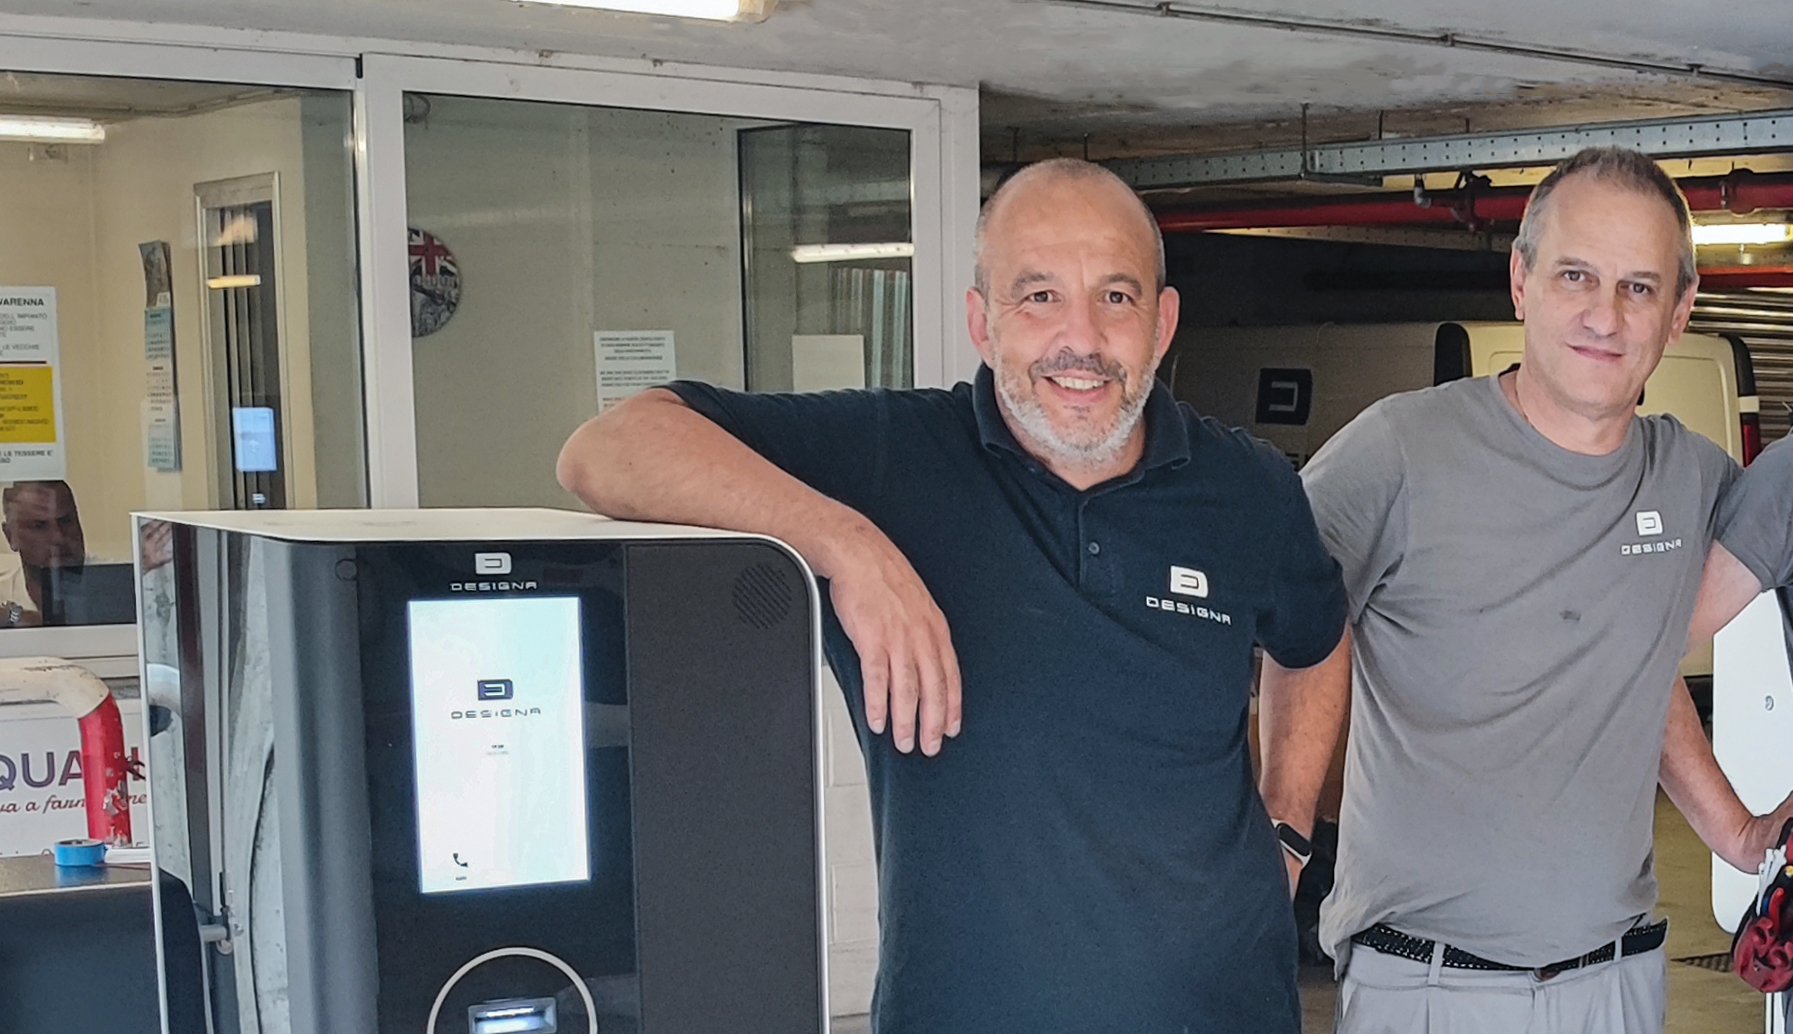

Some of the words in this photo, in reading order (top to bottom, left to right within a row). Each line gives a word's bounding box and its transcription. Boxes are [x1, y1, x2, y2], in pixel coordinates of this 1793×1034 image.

[1621, 538, 1682, 555] DESIGNA
[450, 581, 537, 592] DESIGNA
[1146, 596, 1231, 625] DESIGNA
[451, 707, 541, 719] DESIGNA
